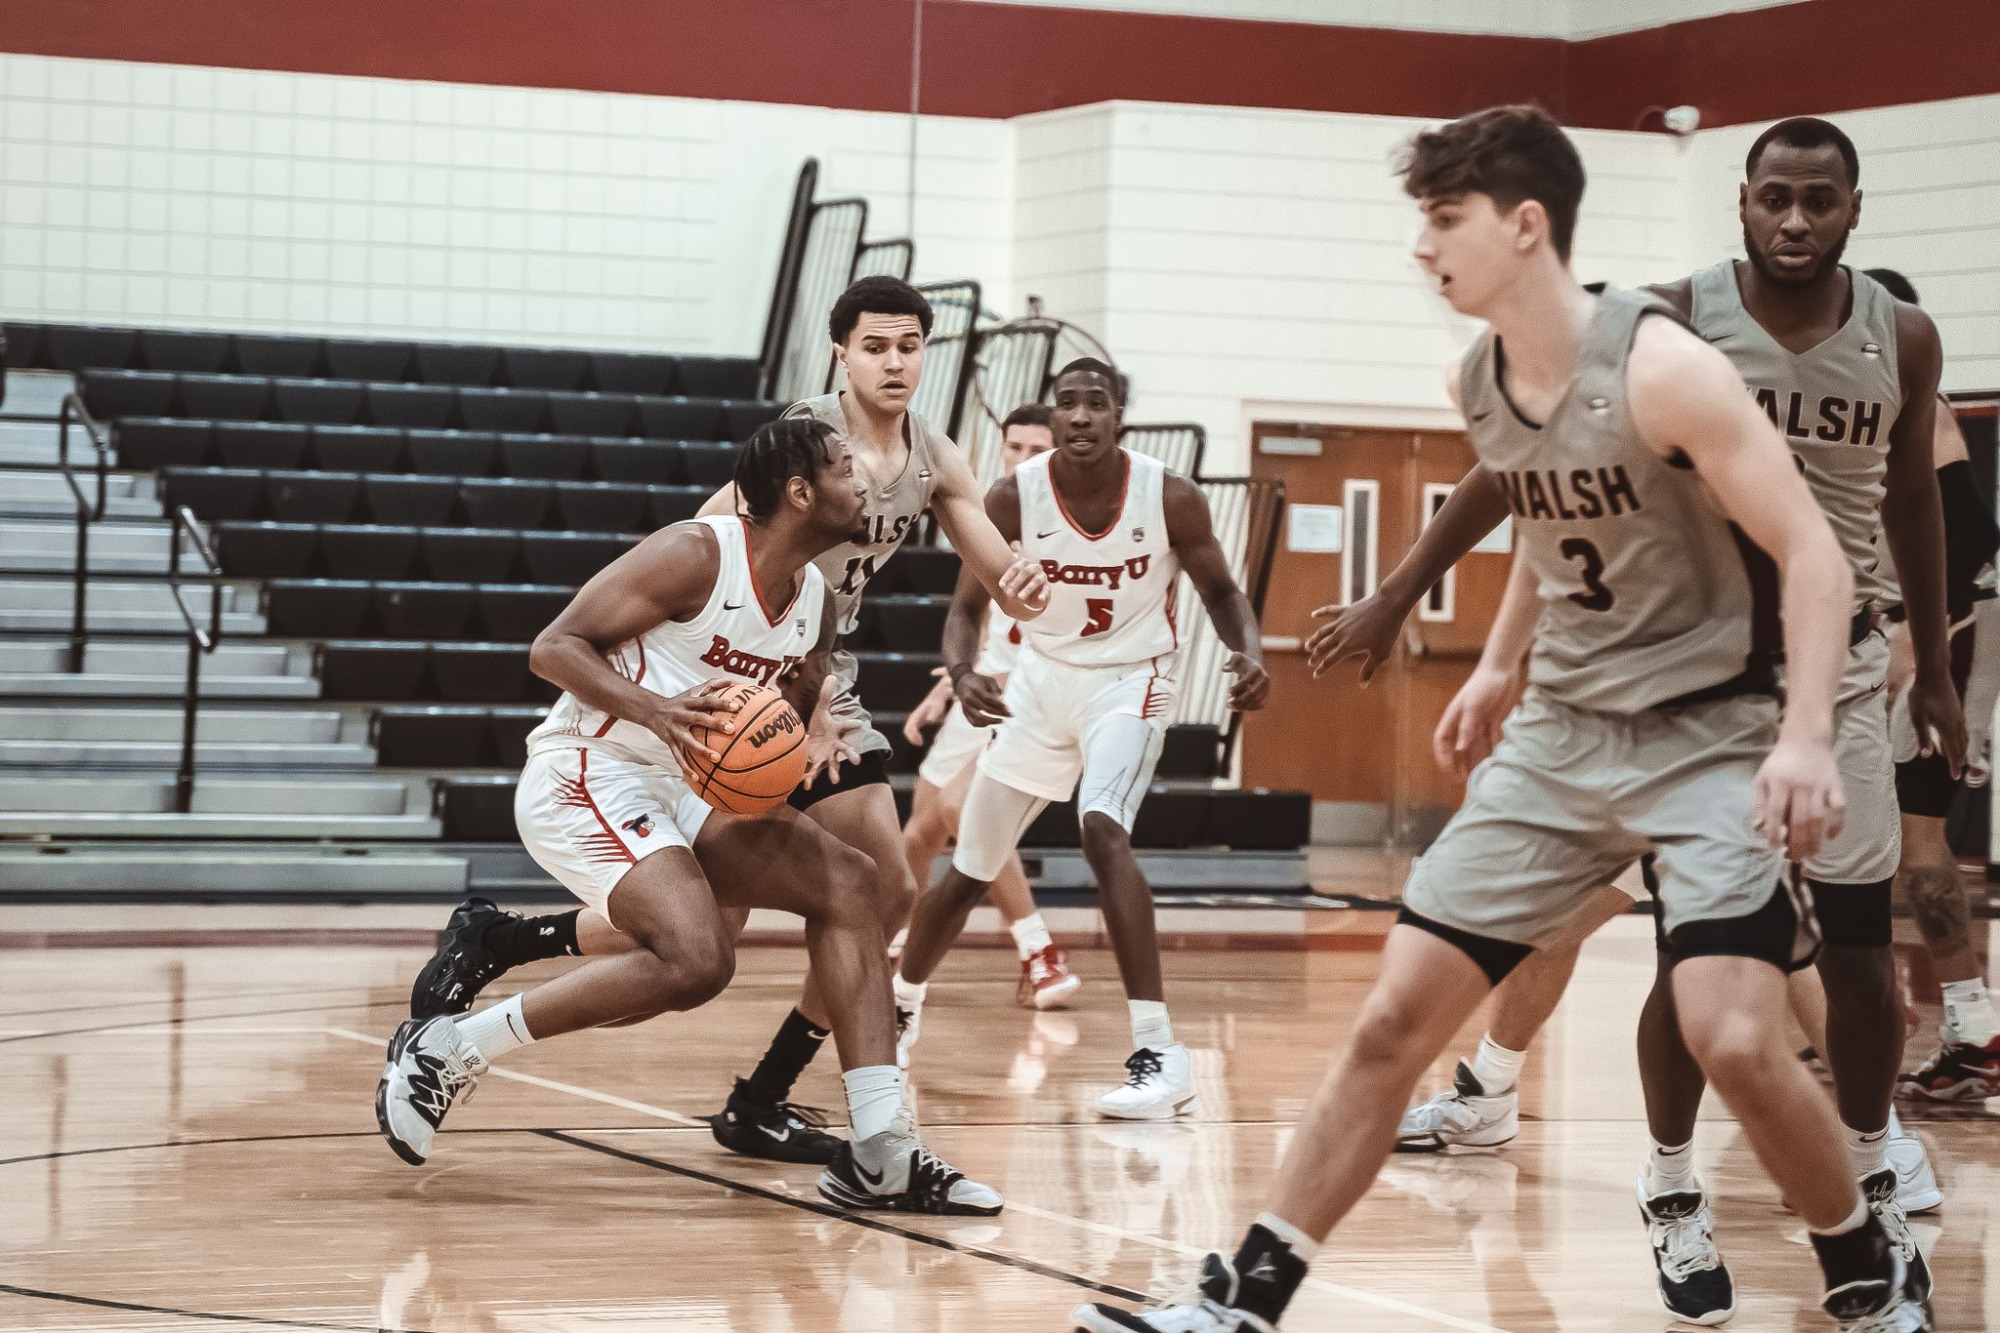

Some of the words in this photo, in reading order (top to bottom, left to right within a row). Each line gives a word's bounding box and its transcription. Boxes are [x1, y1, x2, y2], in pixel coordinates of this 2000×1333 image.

[1747, 387, 1882, 446] ALSH
[1560, 537, 1615, 613] 3
[1080, 598, 1114, 637] 5
